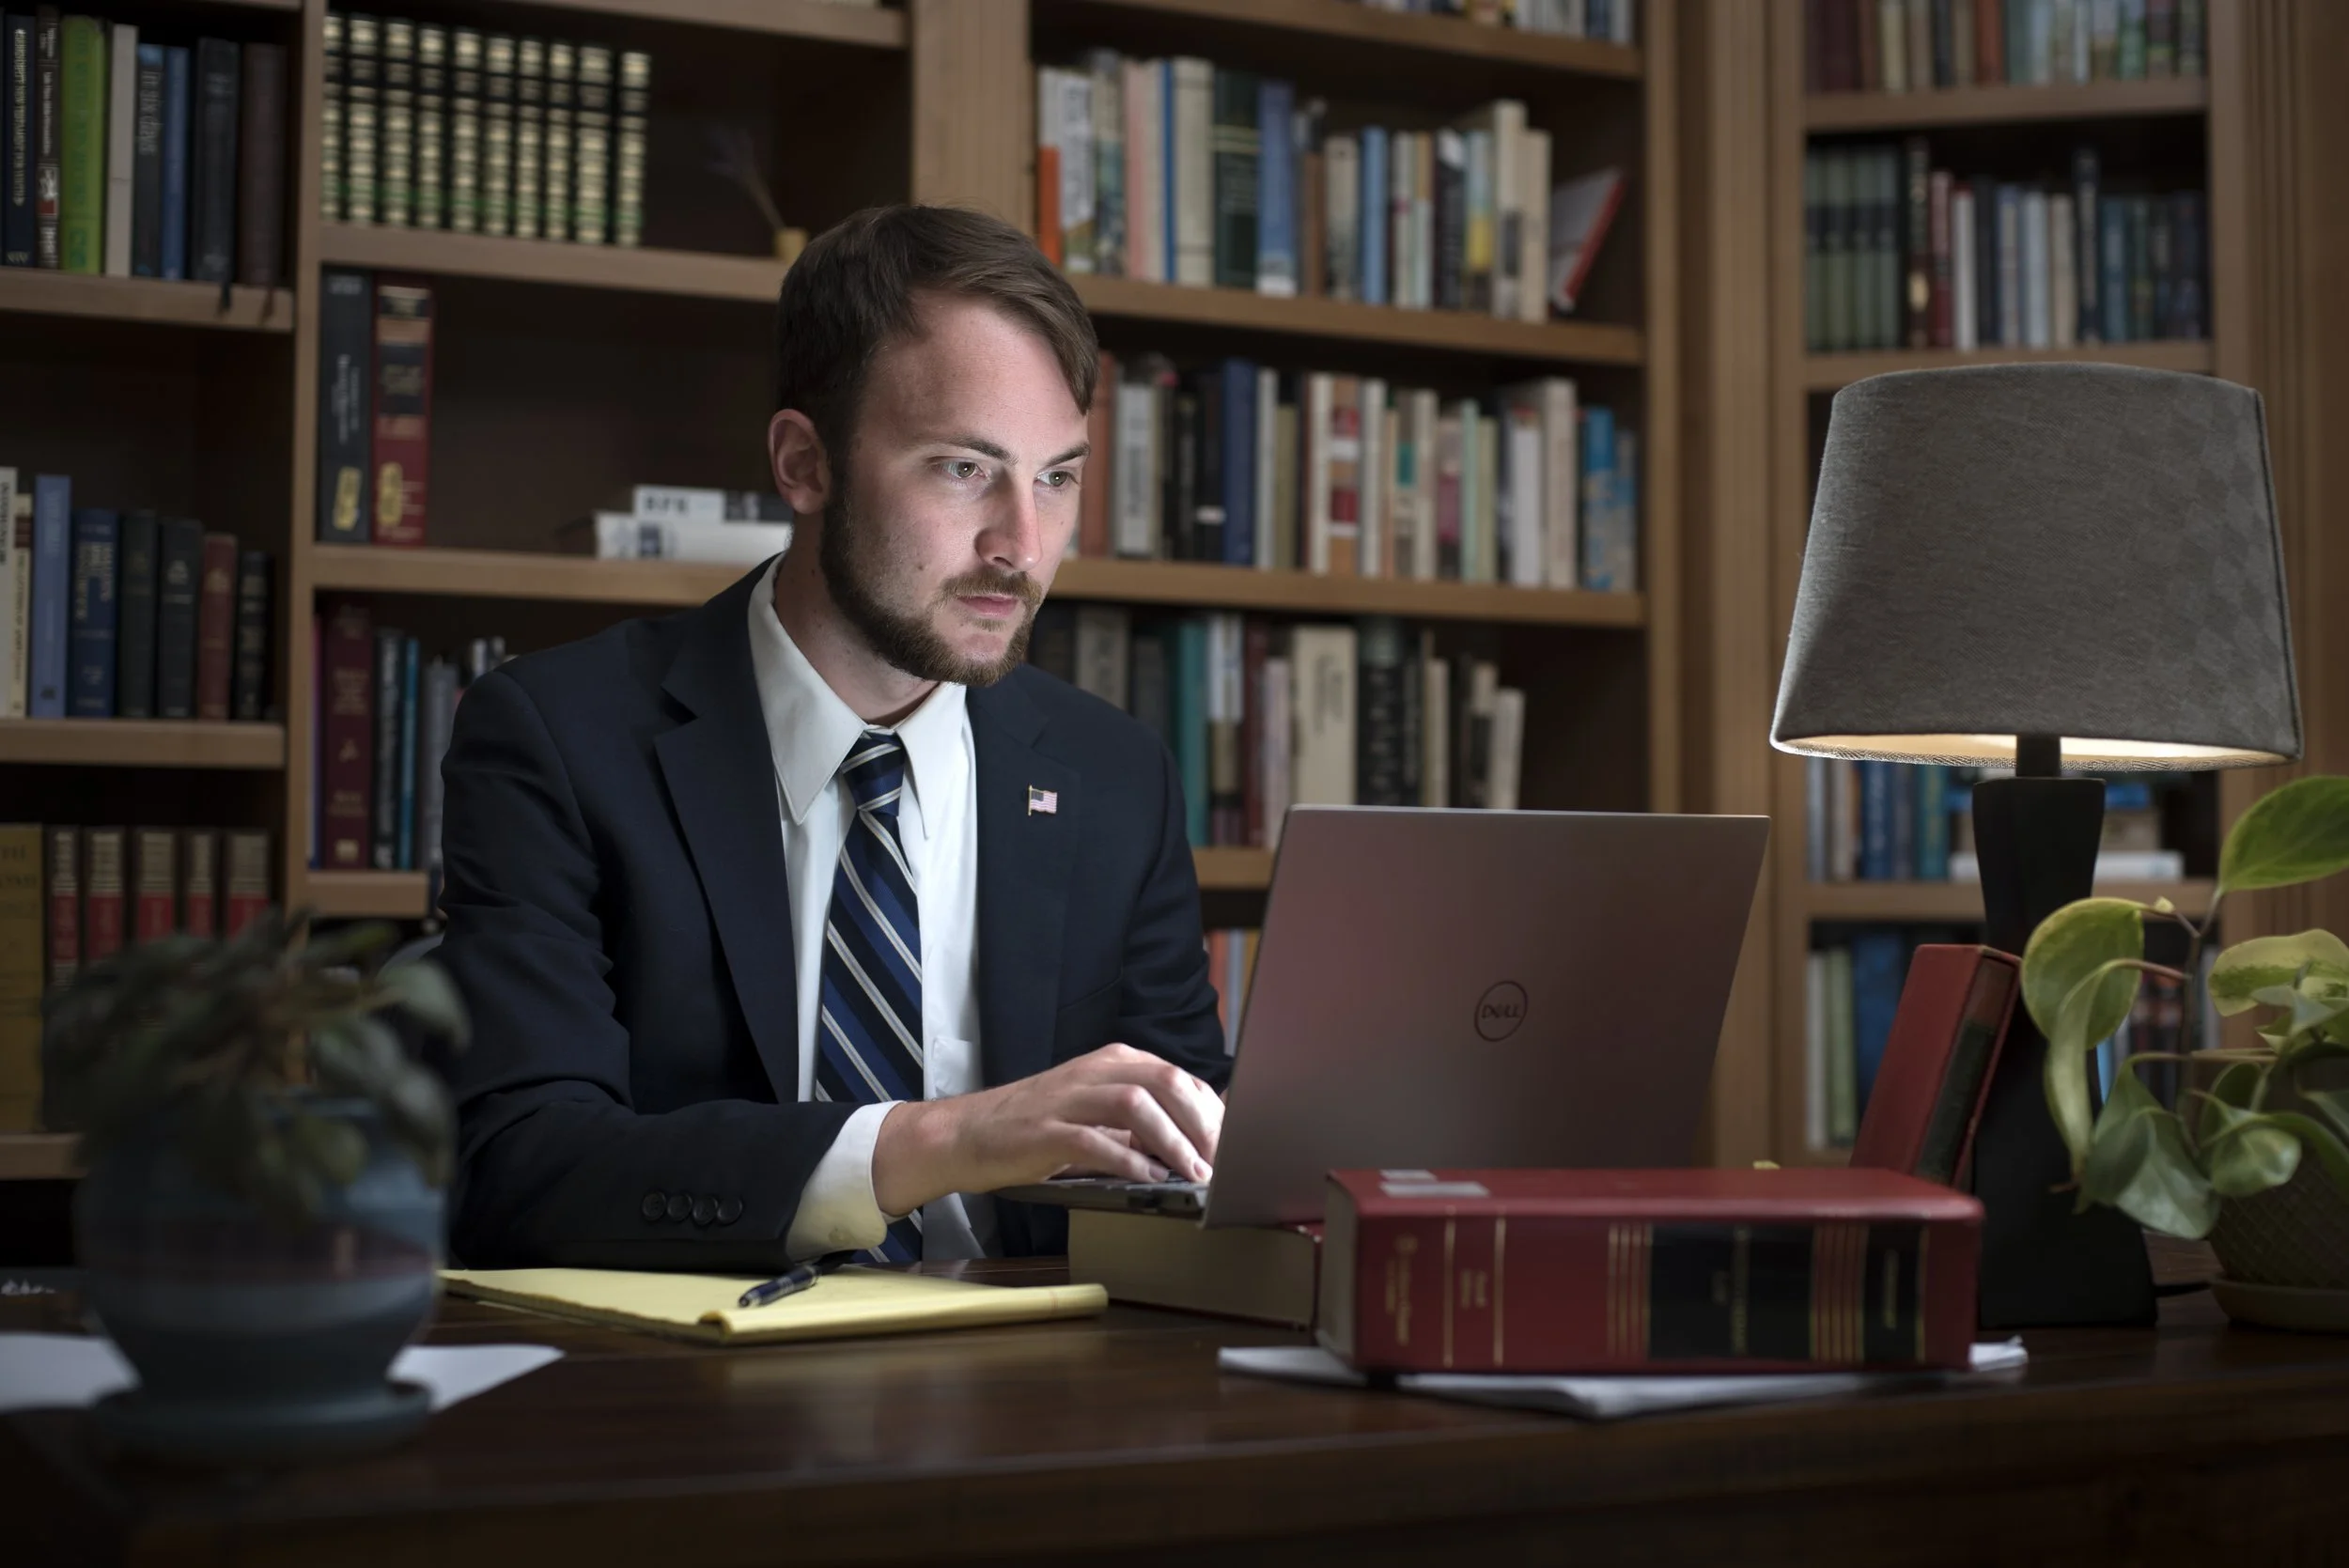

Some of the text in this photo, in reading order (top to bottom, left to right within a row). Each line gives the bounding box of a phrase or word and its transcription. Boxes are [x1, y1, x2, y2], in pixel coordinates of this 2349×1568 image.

[135, 70, 164, 155] in six days
[1481, 1002, 1521, 1018] DELL
